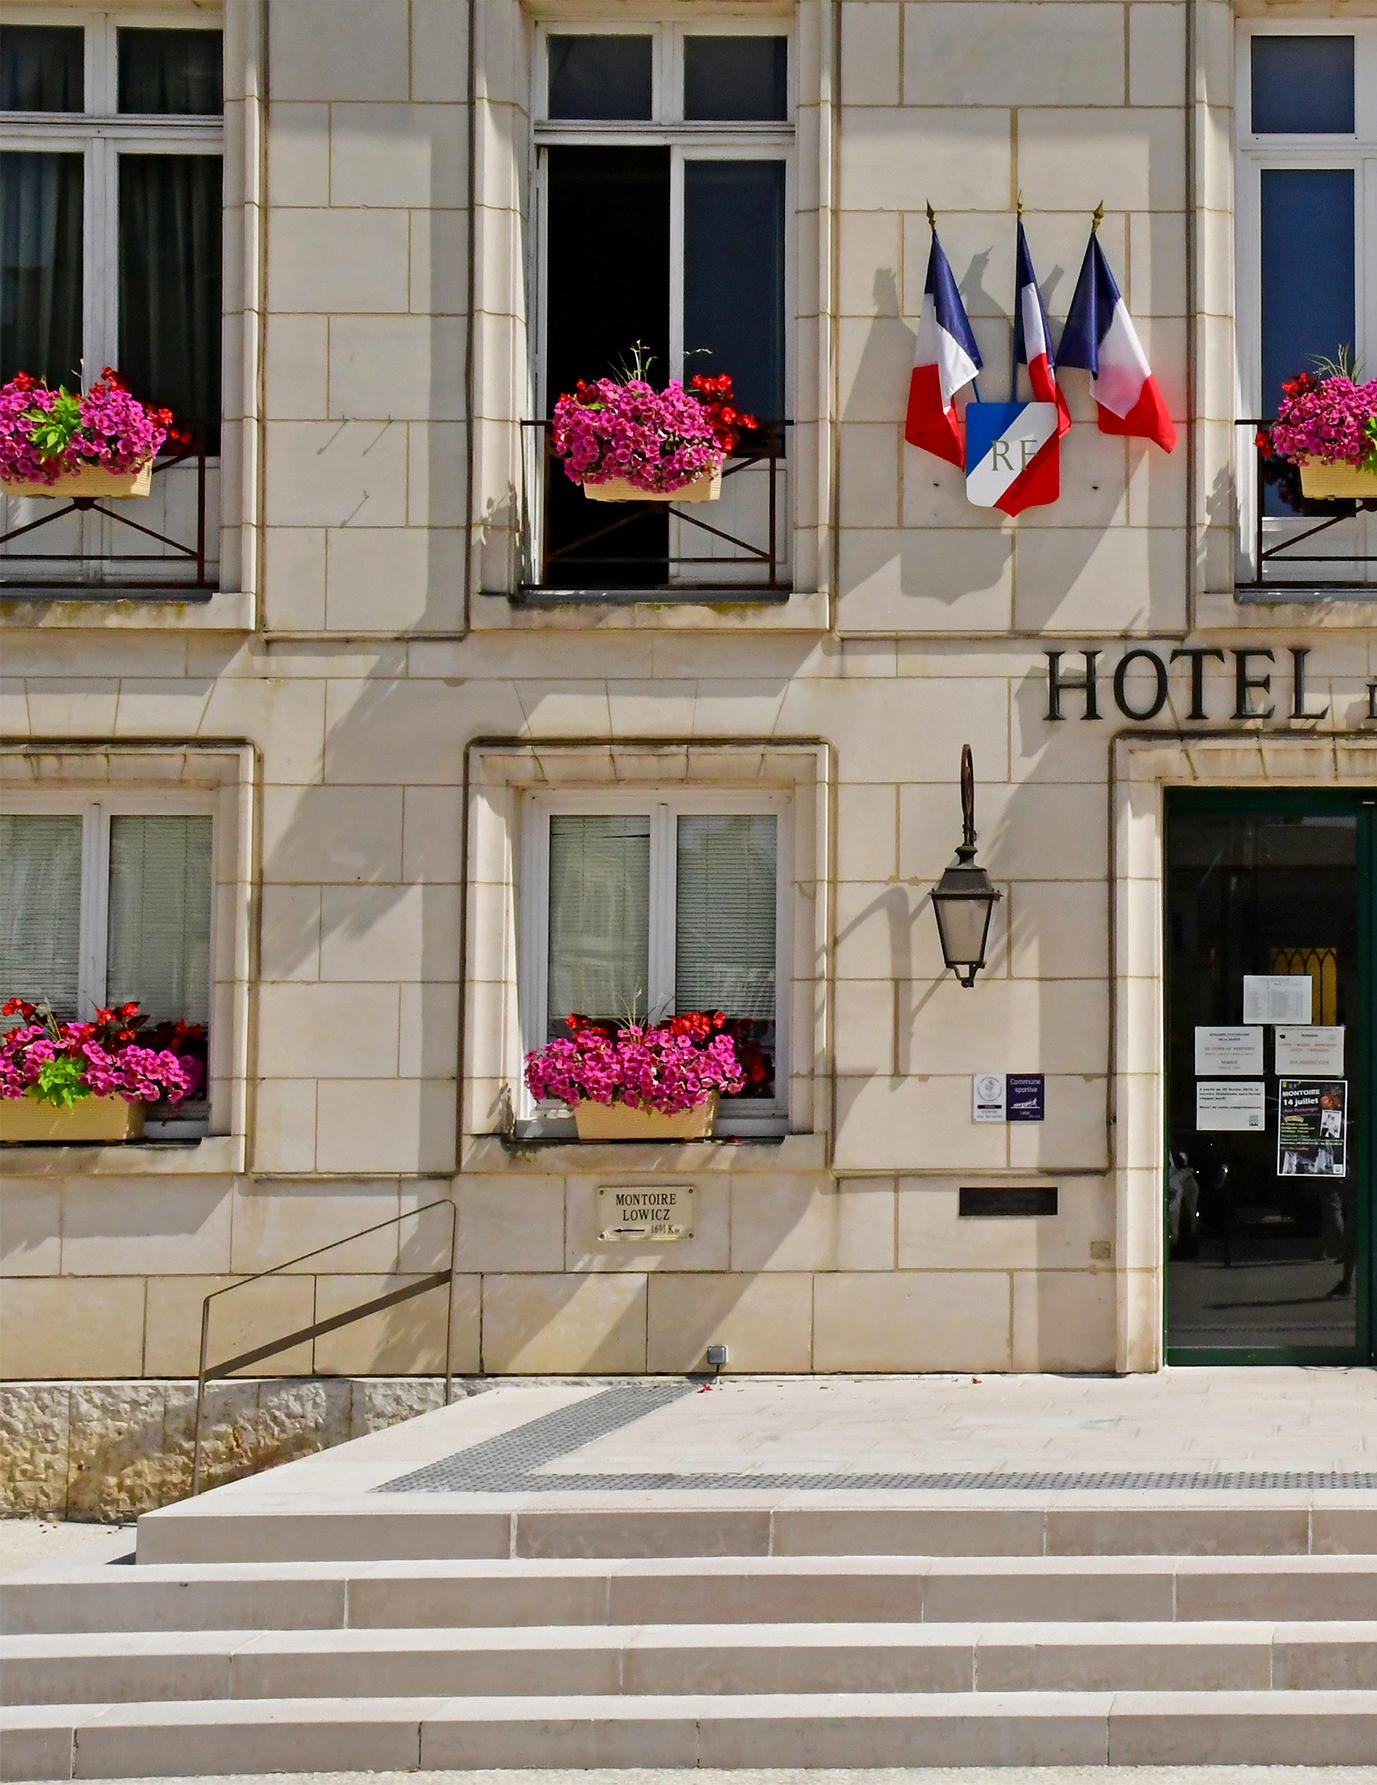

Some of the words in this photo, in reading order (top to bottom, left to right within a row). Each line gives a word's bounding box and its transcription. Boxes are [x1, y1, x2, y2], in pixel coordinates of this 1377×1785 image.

[991, 439, 1038, 471] RF
[1043, 648, 1330, 721] HOTEL
[1282, 1088, 1321, 1097] MONTOIRE
[1294, 1097, 1319, 1107] juillet
[615, 1193, 677, 1206] MONTOIRE
[622, 1209, 671, 1221] LOWICZ
